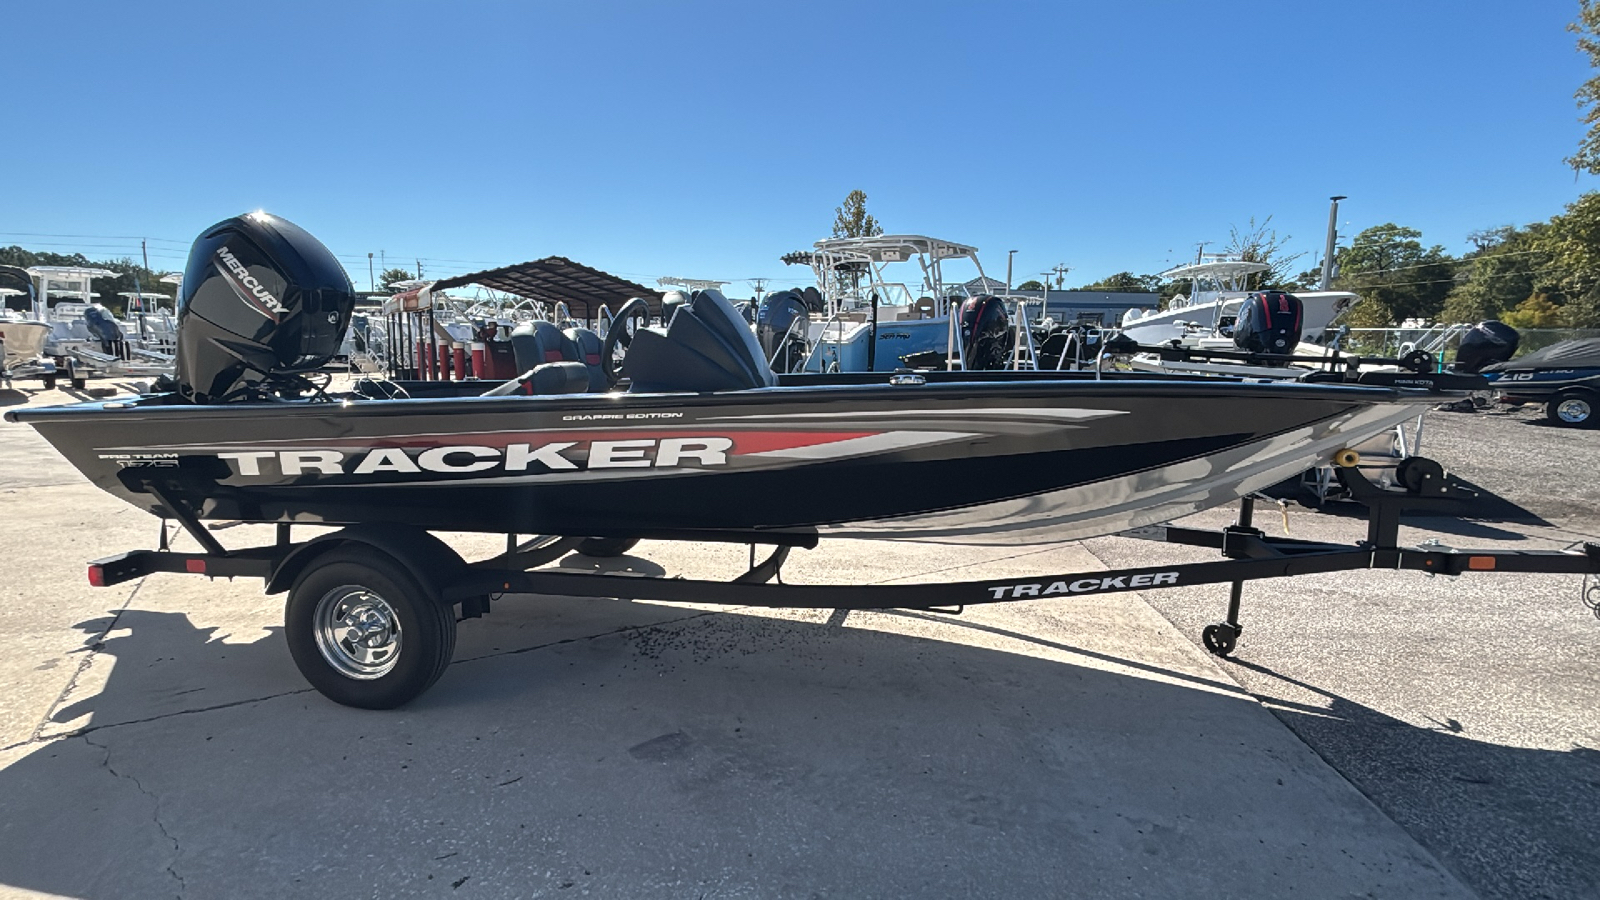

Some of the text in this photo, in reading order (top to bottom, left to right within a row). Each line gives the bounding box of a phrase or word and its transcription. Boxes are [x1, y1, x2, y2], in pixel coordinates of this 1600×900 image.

[216, 246, 290, 314] MERCURY
[217, 436, 733, 477] TRACKER
[988, 571, 1180, 599] TRACKER
